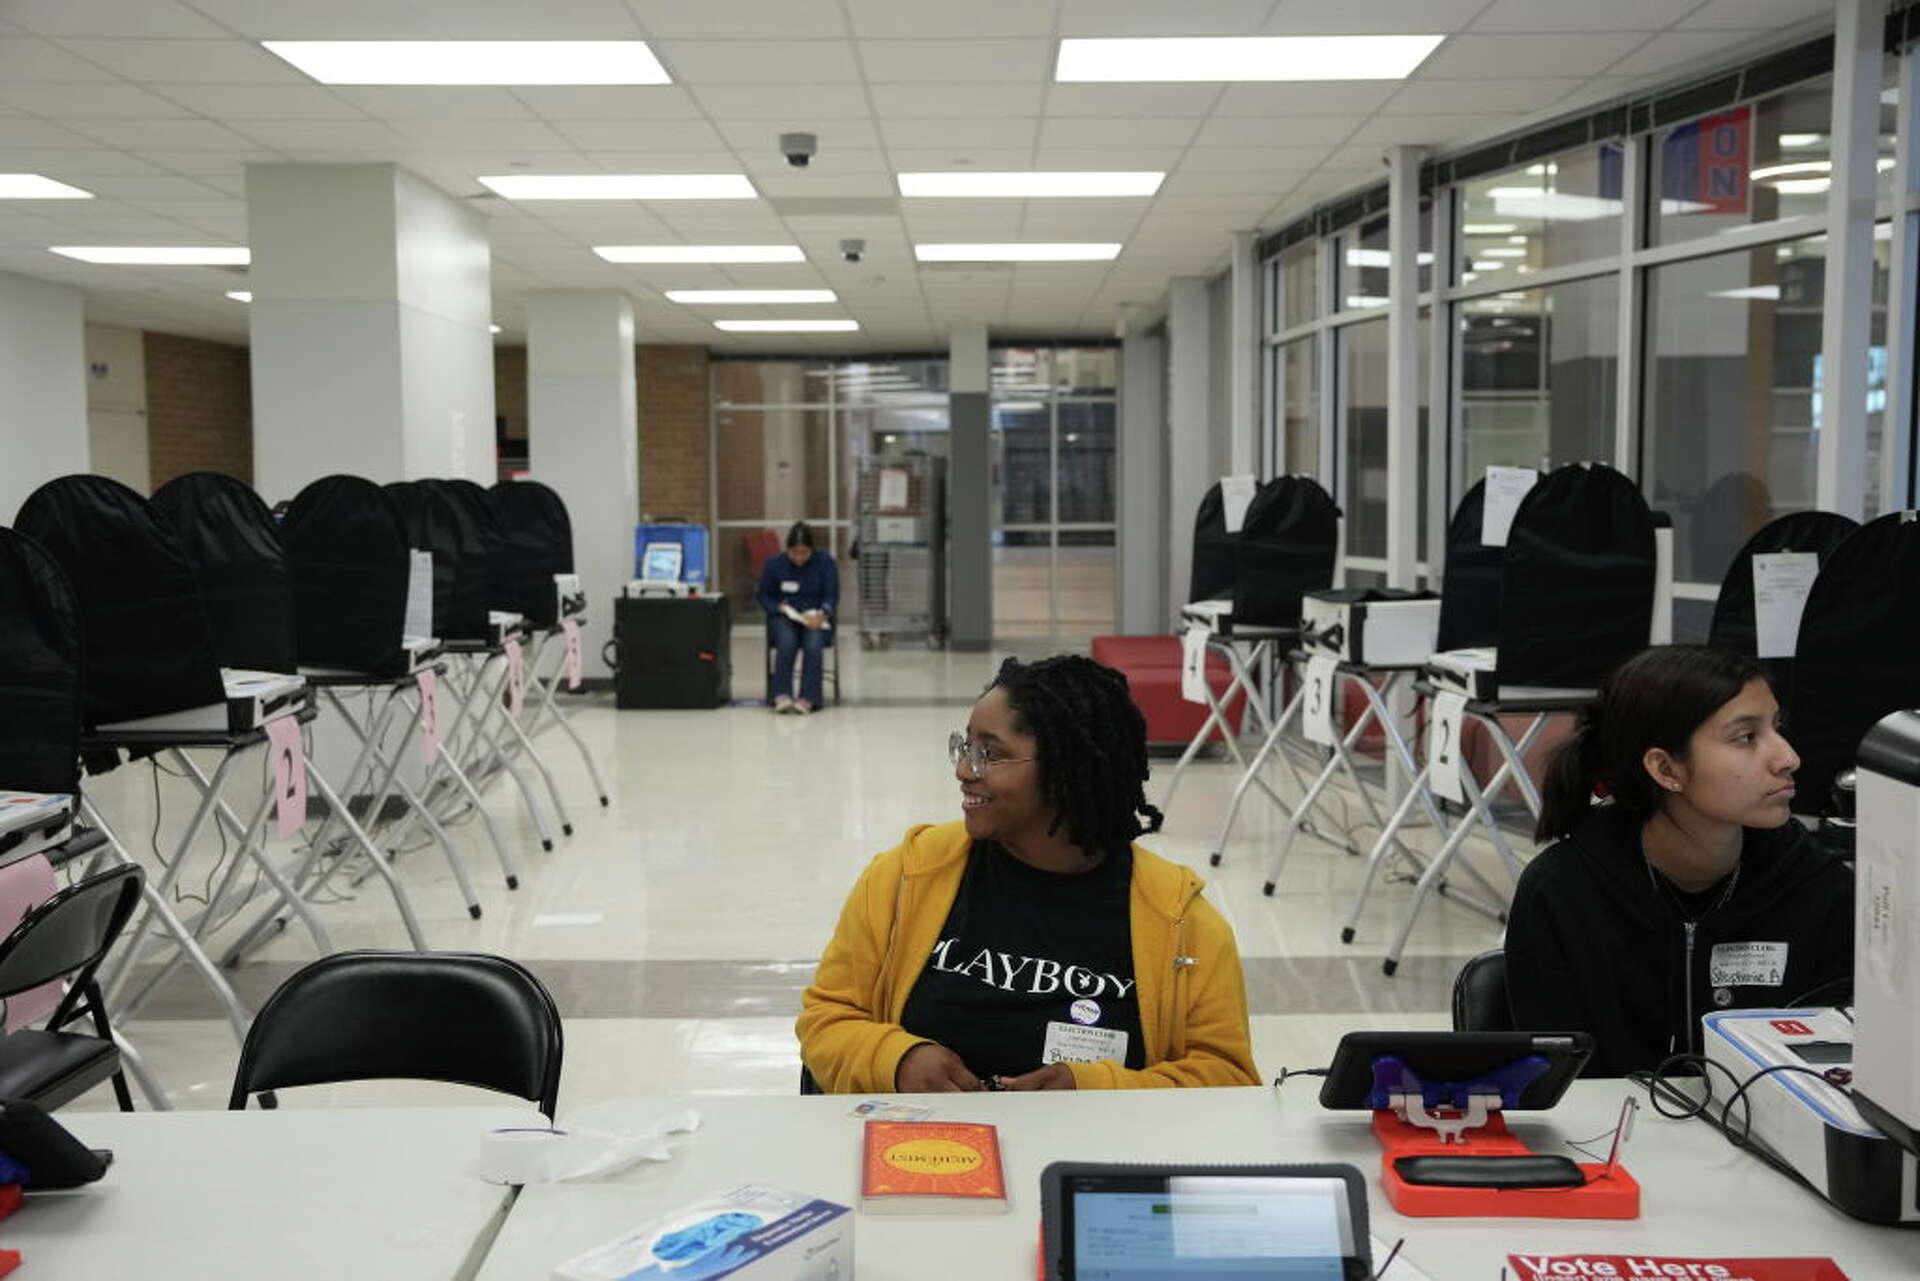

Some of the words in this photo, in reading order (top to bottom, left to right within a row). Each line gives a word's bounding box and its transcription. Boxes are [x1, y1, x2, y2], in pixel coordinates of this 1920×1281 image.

[1439, 718, 1450, 765] 2
[283, 747, 296, 799] 2
[932, 937, 1135, 998] LAYBOY
[1518, 1256, 1617, 1276] Vote
[1625, 1257, 1731, 1278] Here
